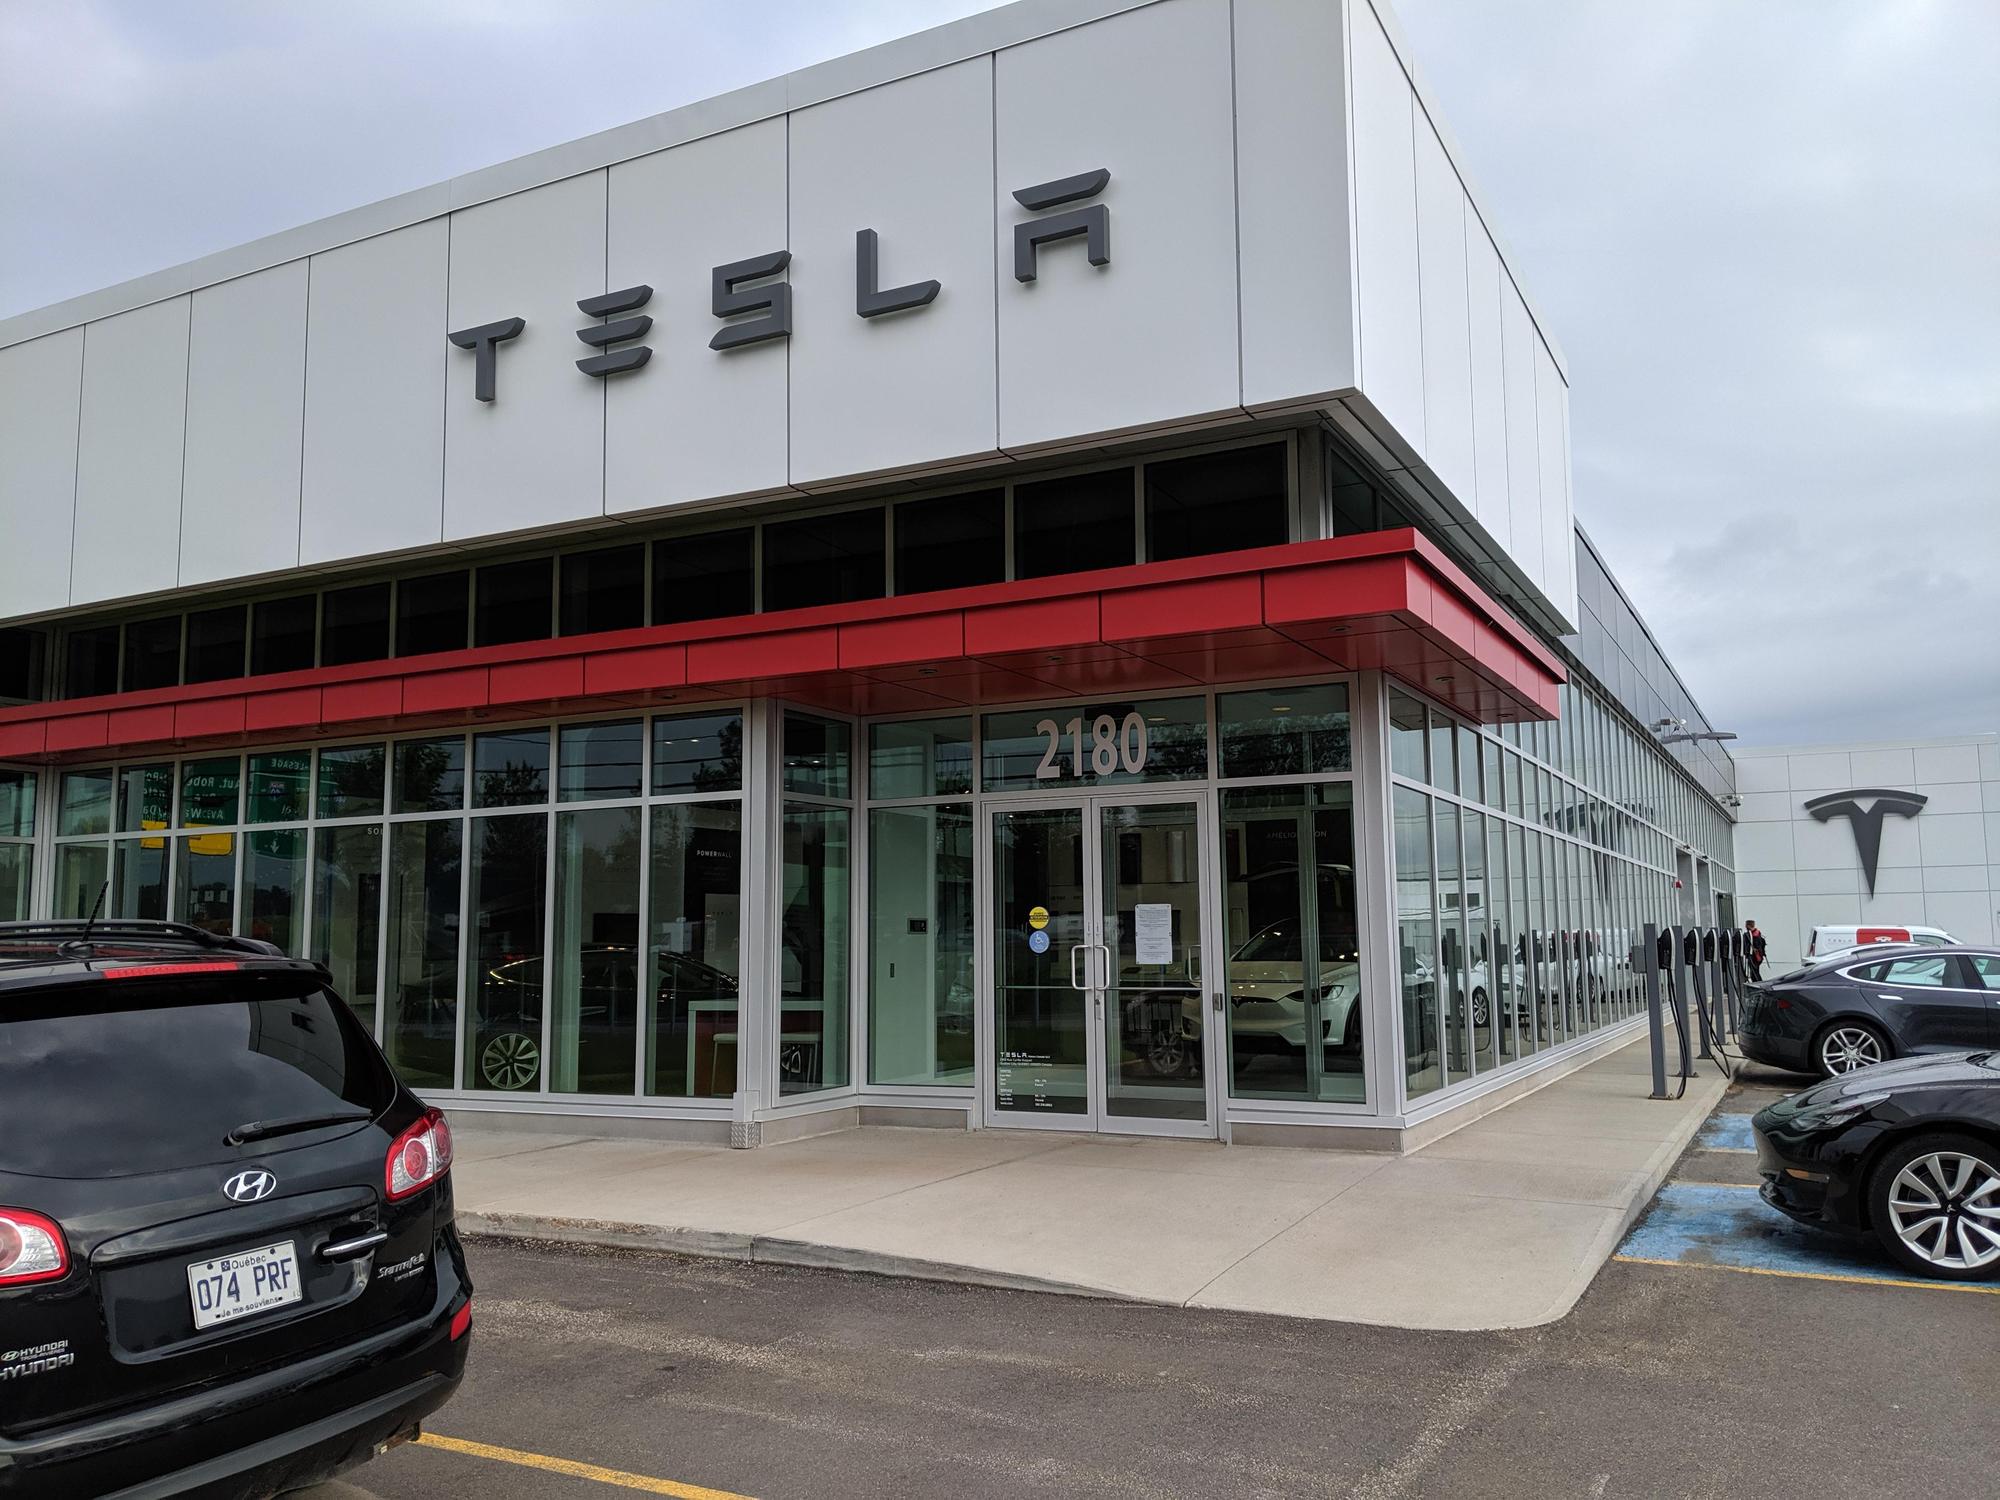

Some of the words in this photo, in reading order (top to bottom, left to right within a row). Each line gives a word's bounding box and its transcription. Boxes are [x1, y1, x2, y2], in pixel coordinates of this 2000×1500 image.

[447, 167, 1112, 404] TESLA
[1036, 711, 1148, 779] 2180
[231, 1254, 267, 1270] Québec
[197, 1271, 240, 1311] 074
[252, 1257, 292, 1297] PRF
[221, 1308, 232, 1319] Je
[232, 1305, 245, 1315] me
[245, 1297, 279, 1311] souviens
[20, 1339, 69, 1357] HYUNDAI
[0, 1352, 75, 1380] HYUNDAI
